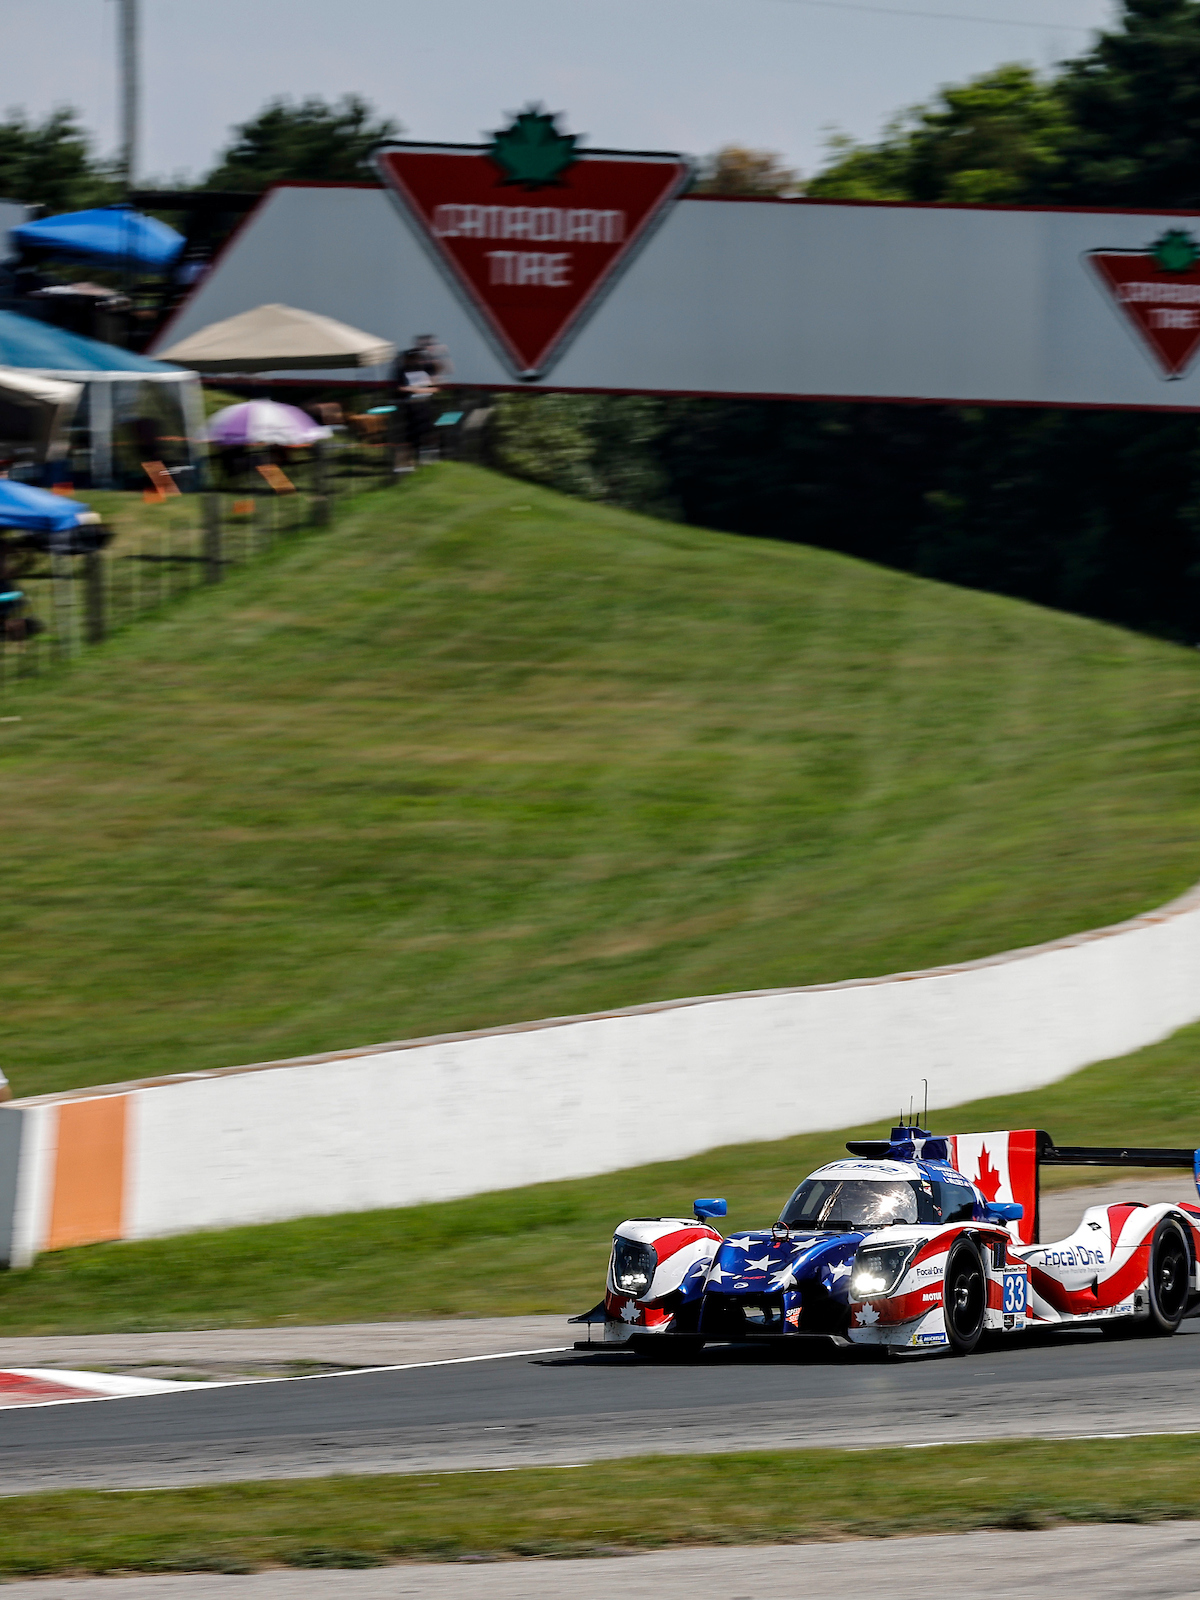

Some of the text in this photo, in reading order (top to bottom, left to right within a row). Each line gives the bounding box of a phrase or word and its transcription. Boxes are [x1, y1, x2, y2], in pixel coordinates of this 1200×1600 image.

[432, 203, 626, 243] CANADIAN
[485, 250, 573, 287] TIRE
[922, 1292, 943, 1302] MOTUL
[1005, 1275, 1025, 1312] 33
